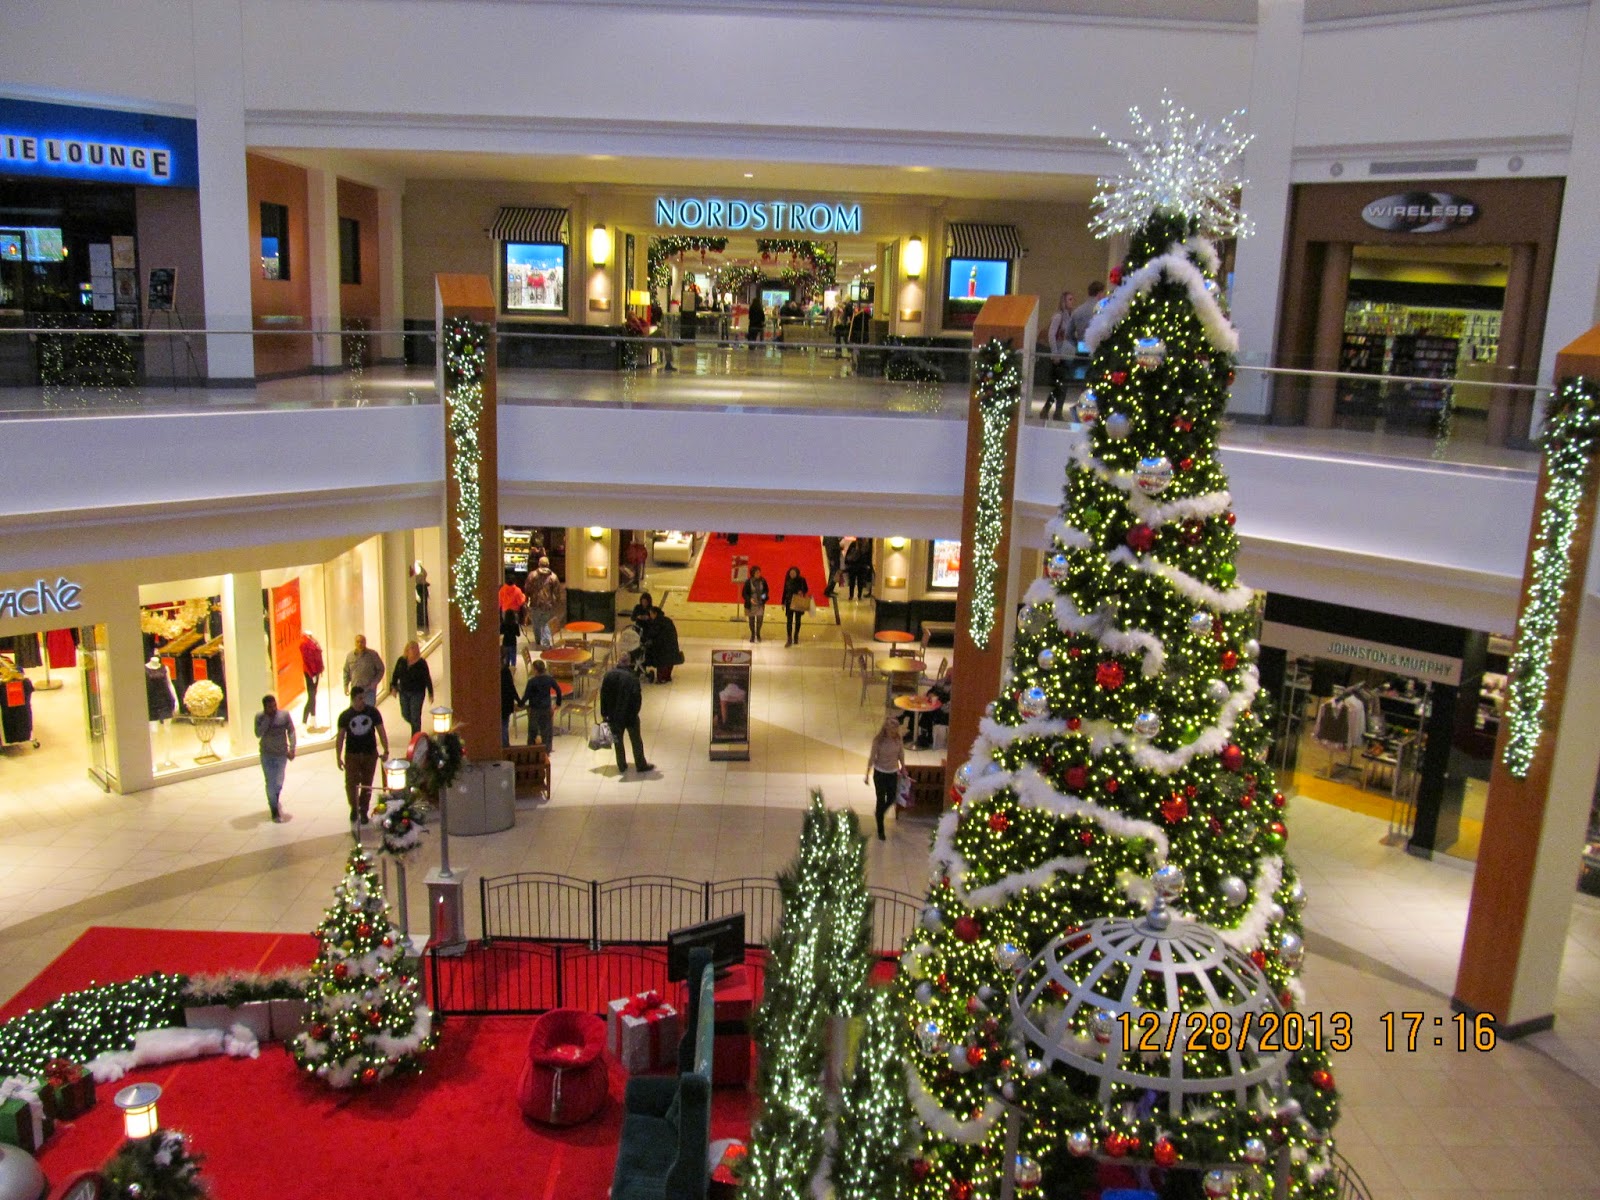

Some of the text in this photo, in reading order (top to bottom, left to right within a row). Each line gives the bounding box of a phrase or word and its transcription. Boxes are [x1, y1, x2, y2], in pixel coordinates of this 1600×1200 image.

[0, 137, 168, 176] IE LOUNGE
[655, 198, 862, 235] NORDSTROM
[1368, 205, 1474, 217] WIRELESS
[1328, 642, 1388, 664] JOHNSTON
[1400, 655, 1453, 676] MURPHY
